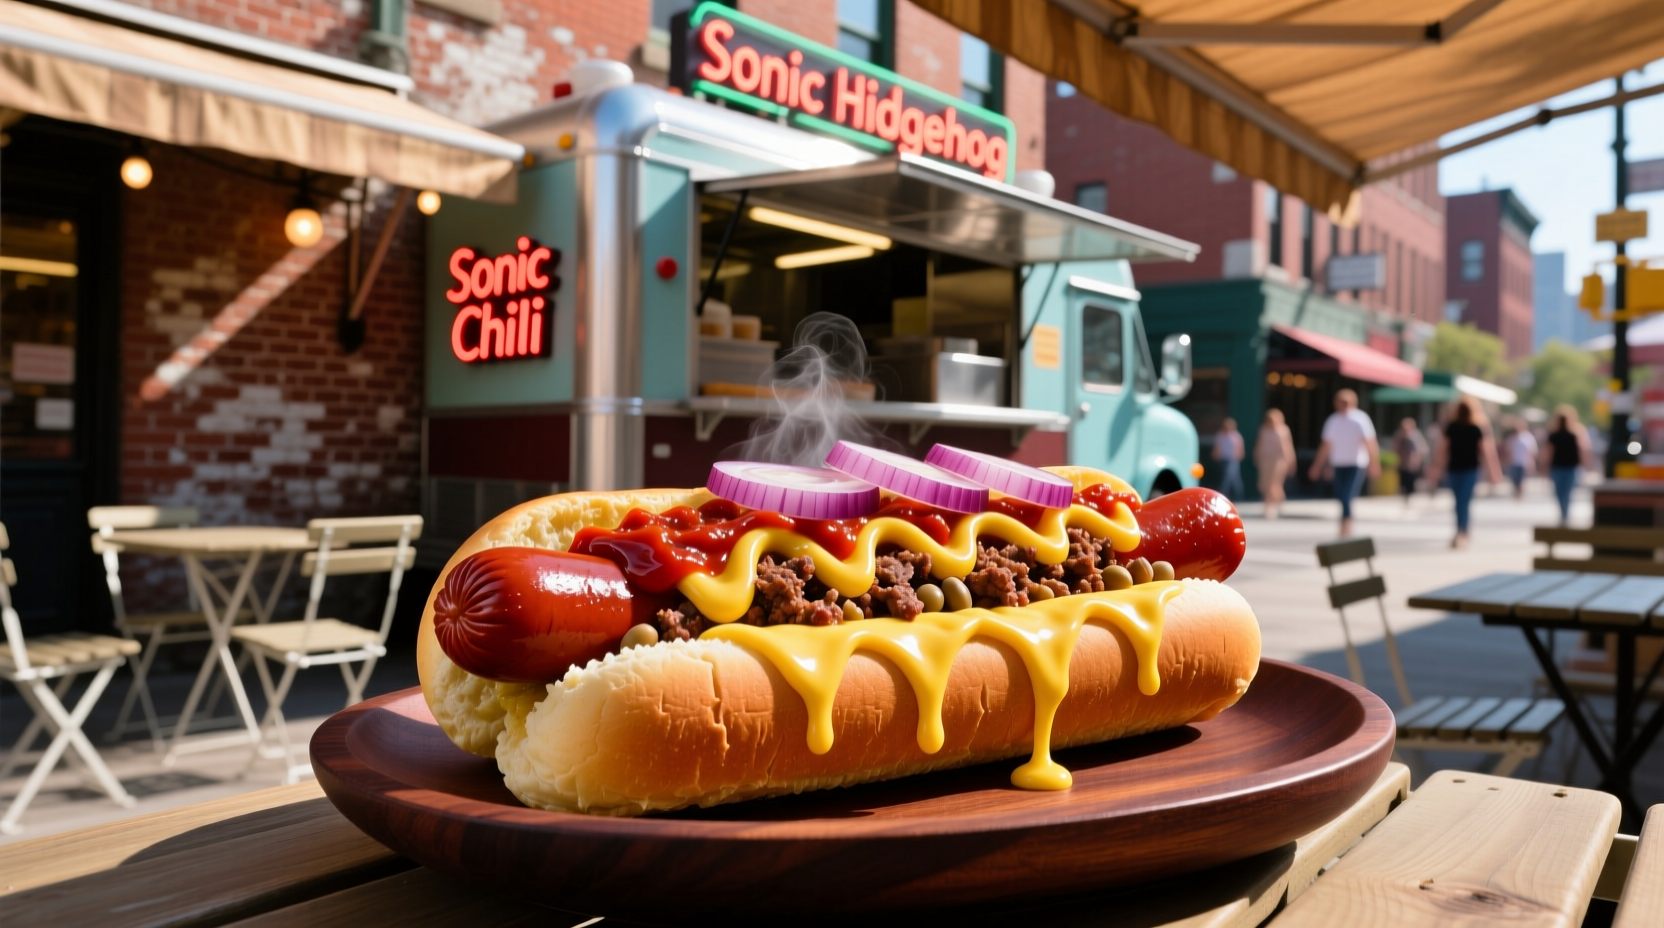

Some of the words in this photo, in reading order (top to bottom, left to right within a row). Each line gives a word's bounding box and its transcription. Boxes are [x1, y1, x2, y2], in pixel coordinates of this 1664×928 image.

[698, 18, 826, 115] Sonic
[833, 66, 1008, 182] Hidgehog
[446, 236, 551, 304] Sonic
[451, 296, 545, 363] Chili
